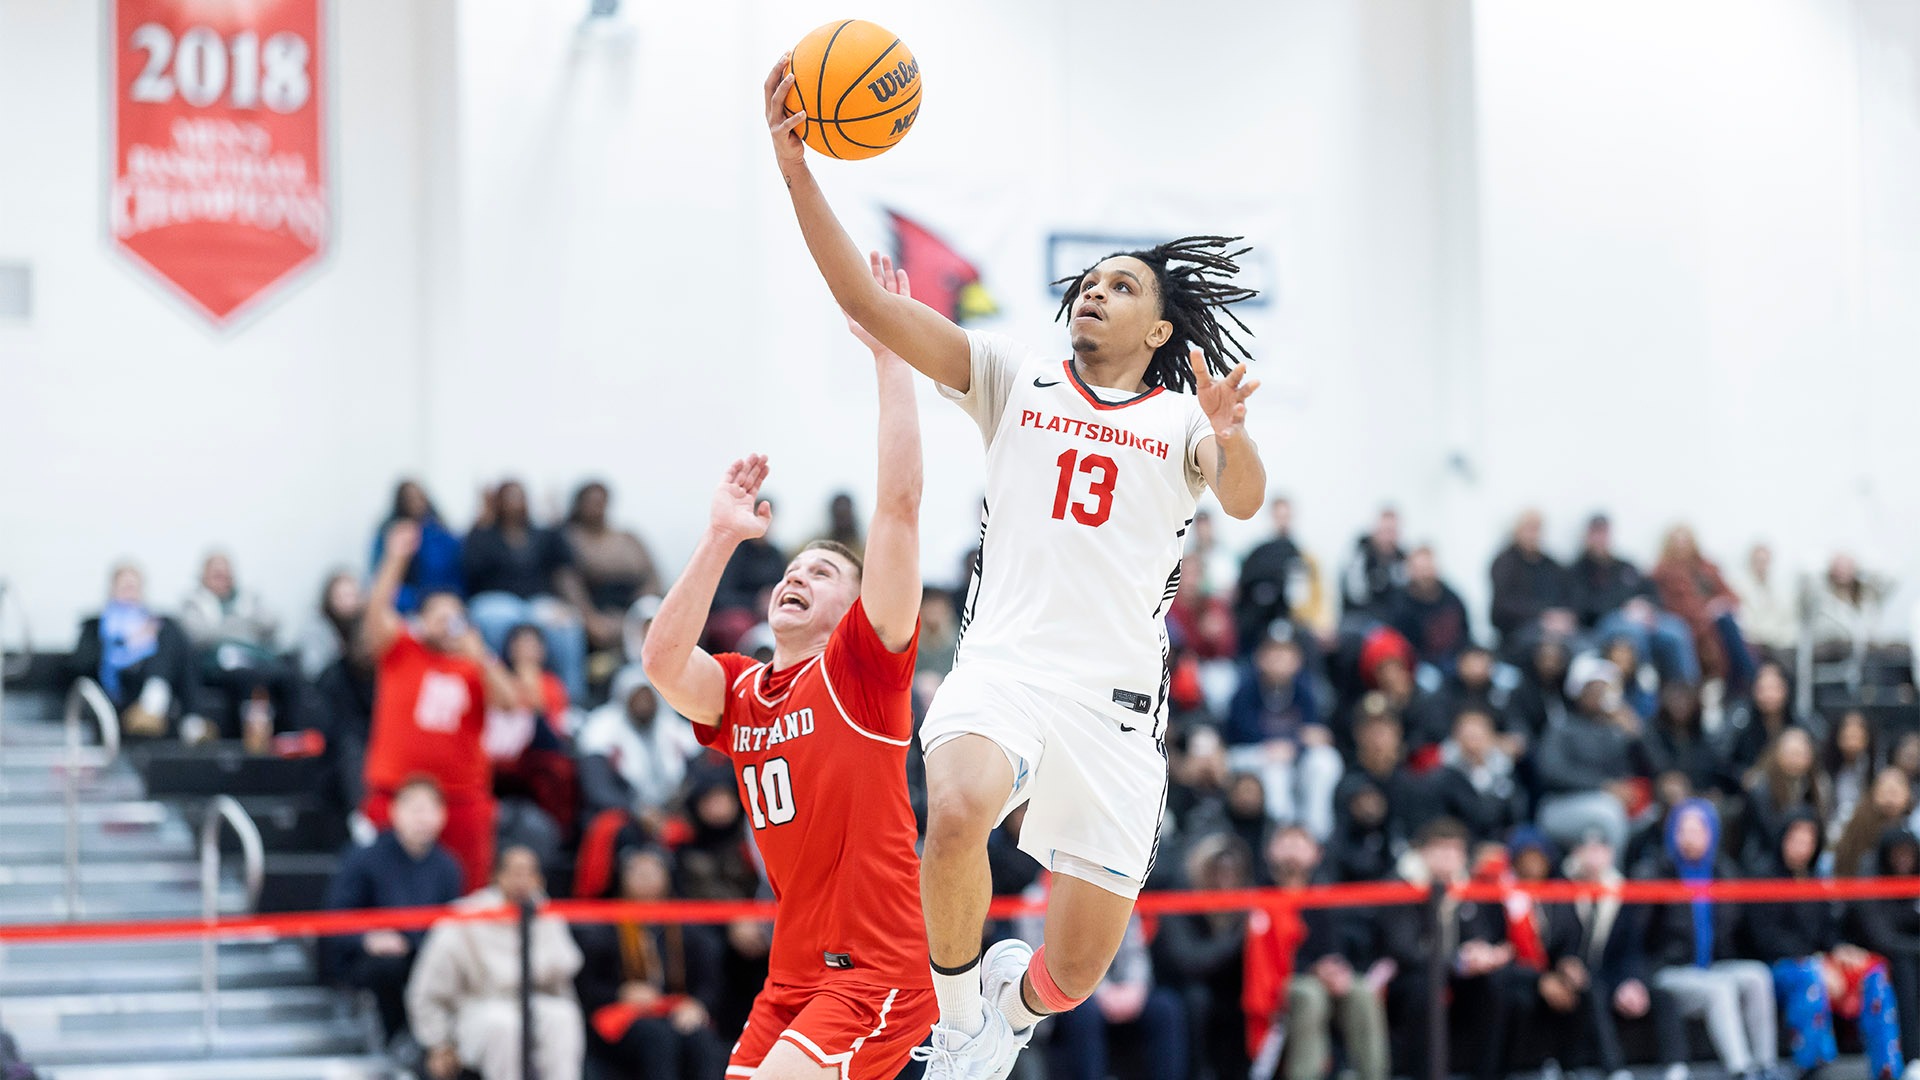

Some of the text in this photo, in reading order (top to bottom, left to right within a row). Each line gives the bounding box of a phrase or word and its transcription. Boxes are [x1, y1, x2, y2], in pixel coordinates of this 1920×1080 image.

[130, 23, 311, 114] 2018
[1020, 409, 1170, 460] PLATTSBURGH
[1051, 448, 1119, 528] 13
[742, 756, 797, 830] 10
